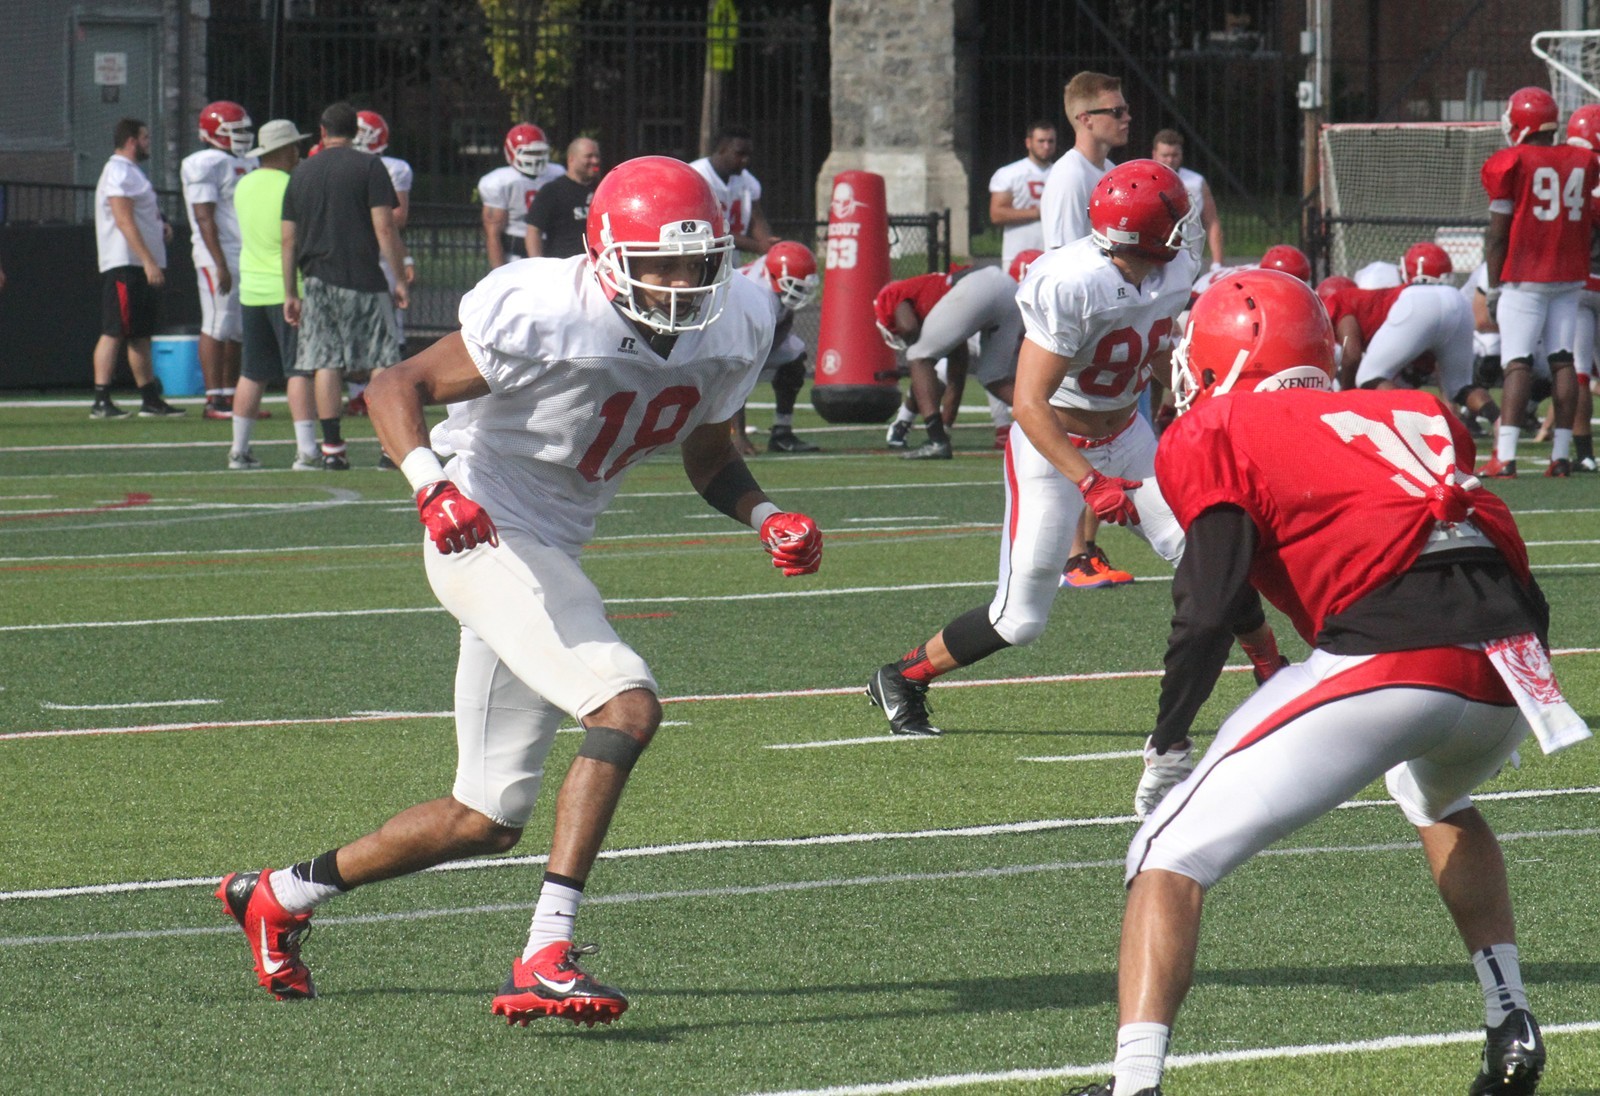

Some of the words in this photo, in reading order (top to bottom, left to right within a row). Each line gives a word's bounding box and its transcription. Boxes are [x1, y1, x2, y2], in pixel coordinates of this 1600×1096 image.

[1533, 167, 1585, 221] 94
[826, 238, 858, 269] 63
[1277, 376, 1325, 390] XENITH
[576, 385, 701, 483] 18
